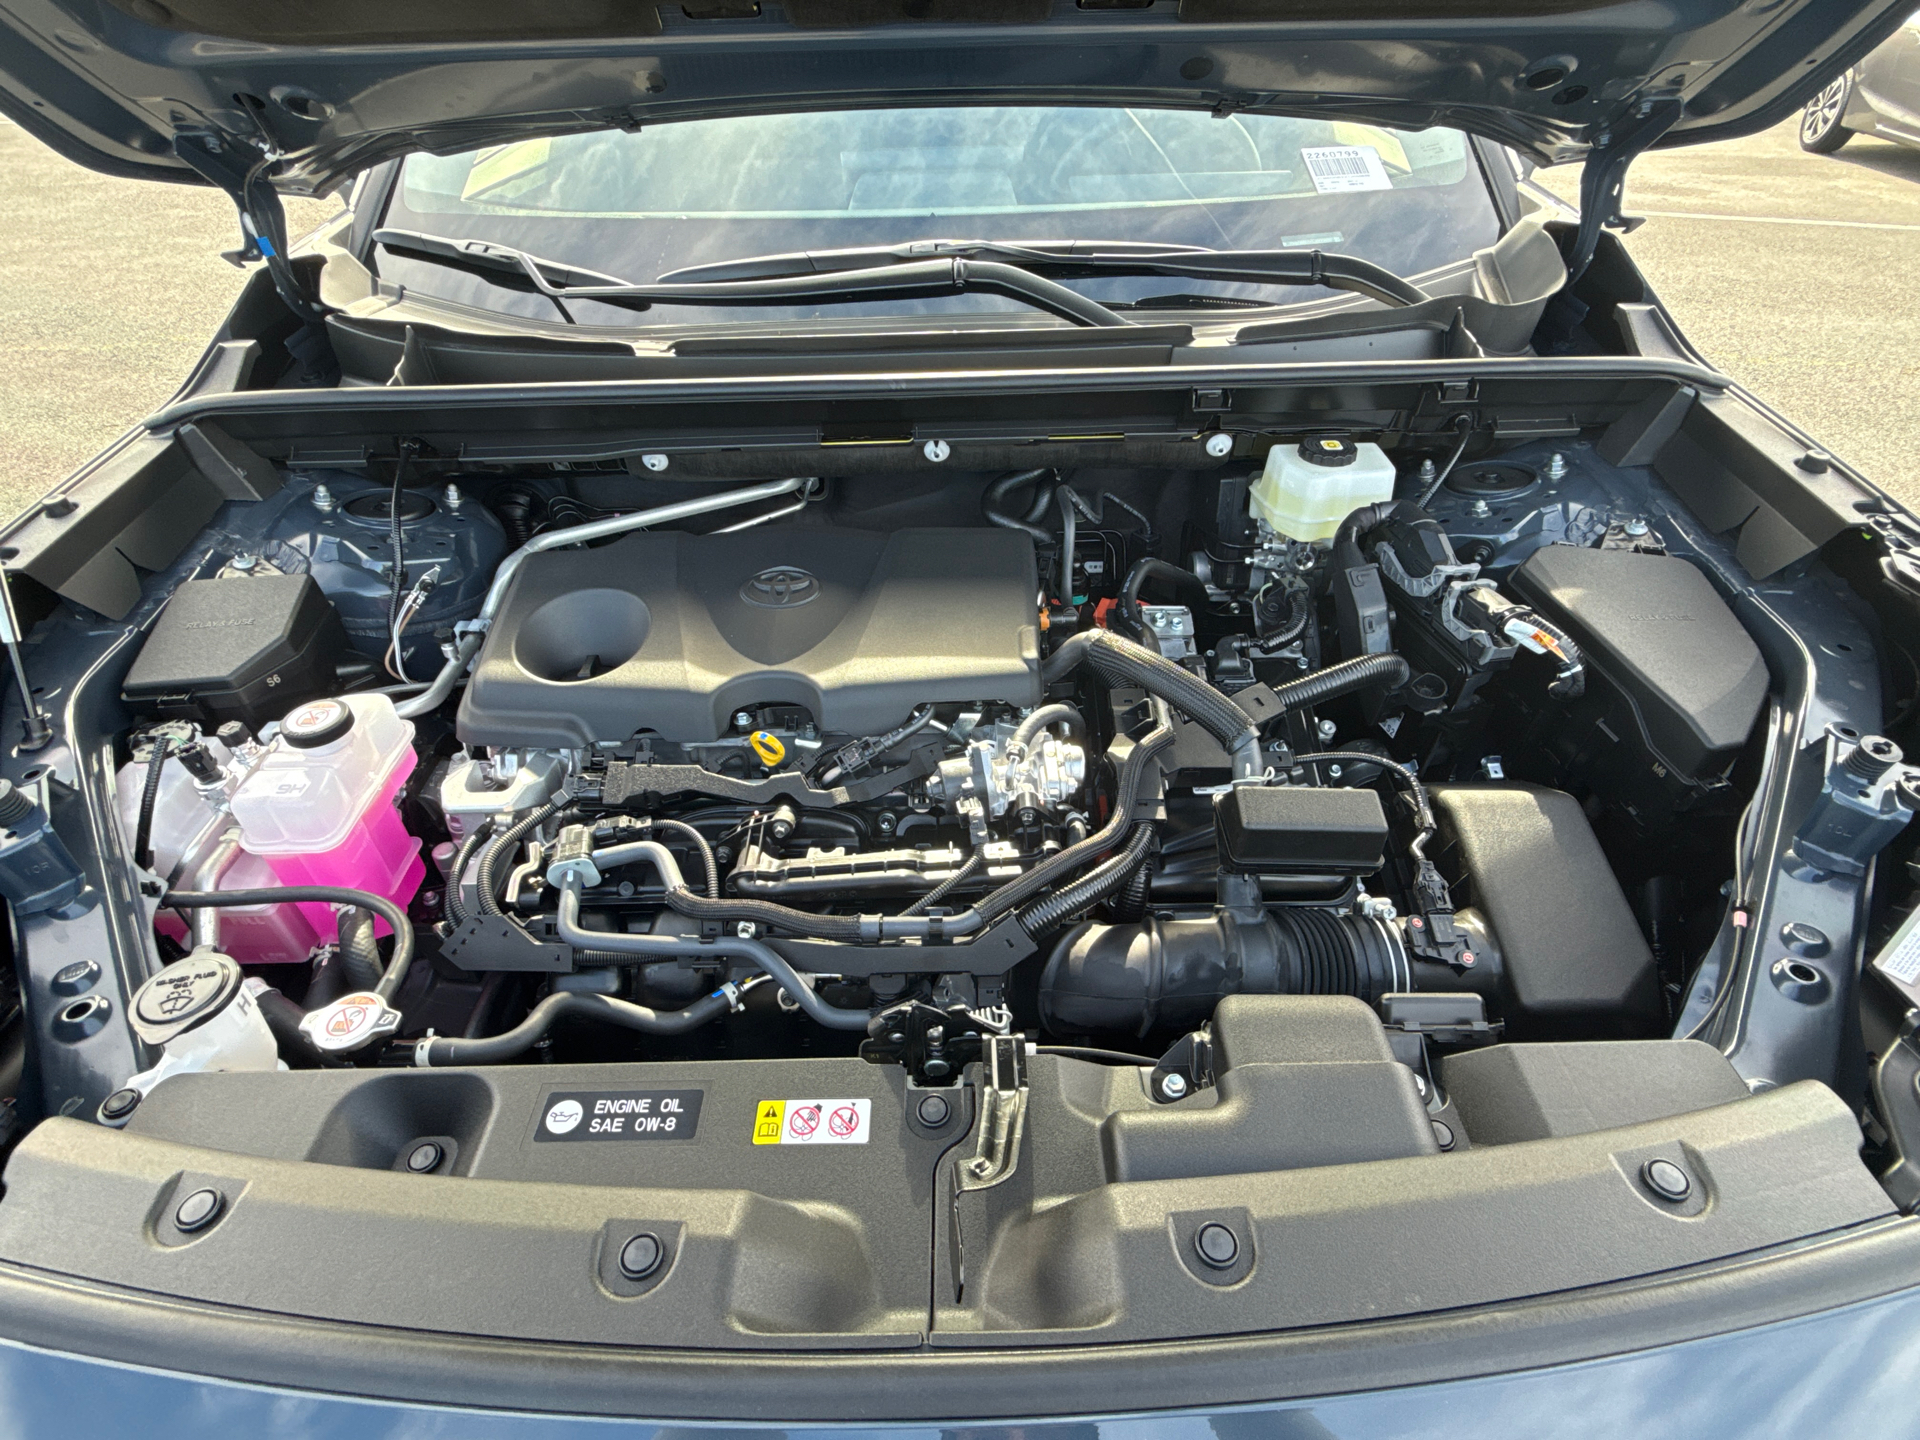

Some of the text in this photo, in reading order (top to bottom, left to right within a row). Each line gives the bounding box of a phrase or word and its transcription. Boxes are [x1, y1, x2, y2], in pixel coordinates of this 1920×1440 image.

[1307, 150, 1359, 159] 2260799
[186, 621, 219, 630] RELAY
[228, 618, 255, 627] FUSE
[266, 674, 281, 688] S6
[1652, 762, 1667, 779] M6
[193, 971, 218, 980] FLUID
[237, 993, 252, 1017] H
[594, 1098, 684, 1114] ENGINE OIL
[588, 1116, 677, 1133] SAE 0W-8
